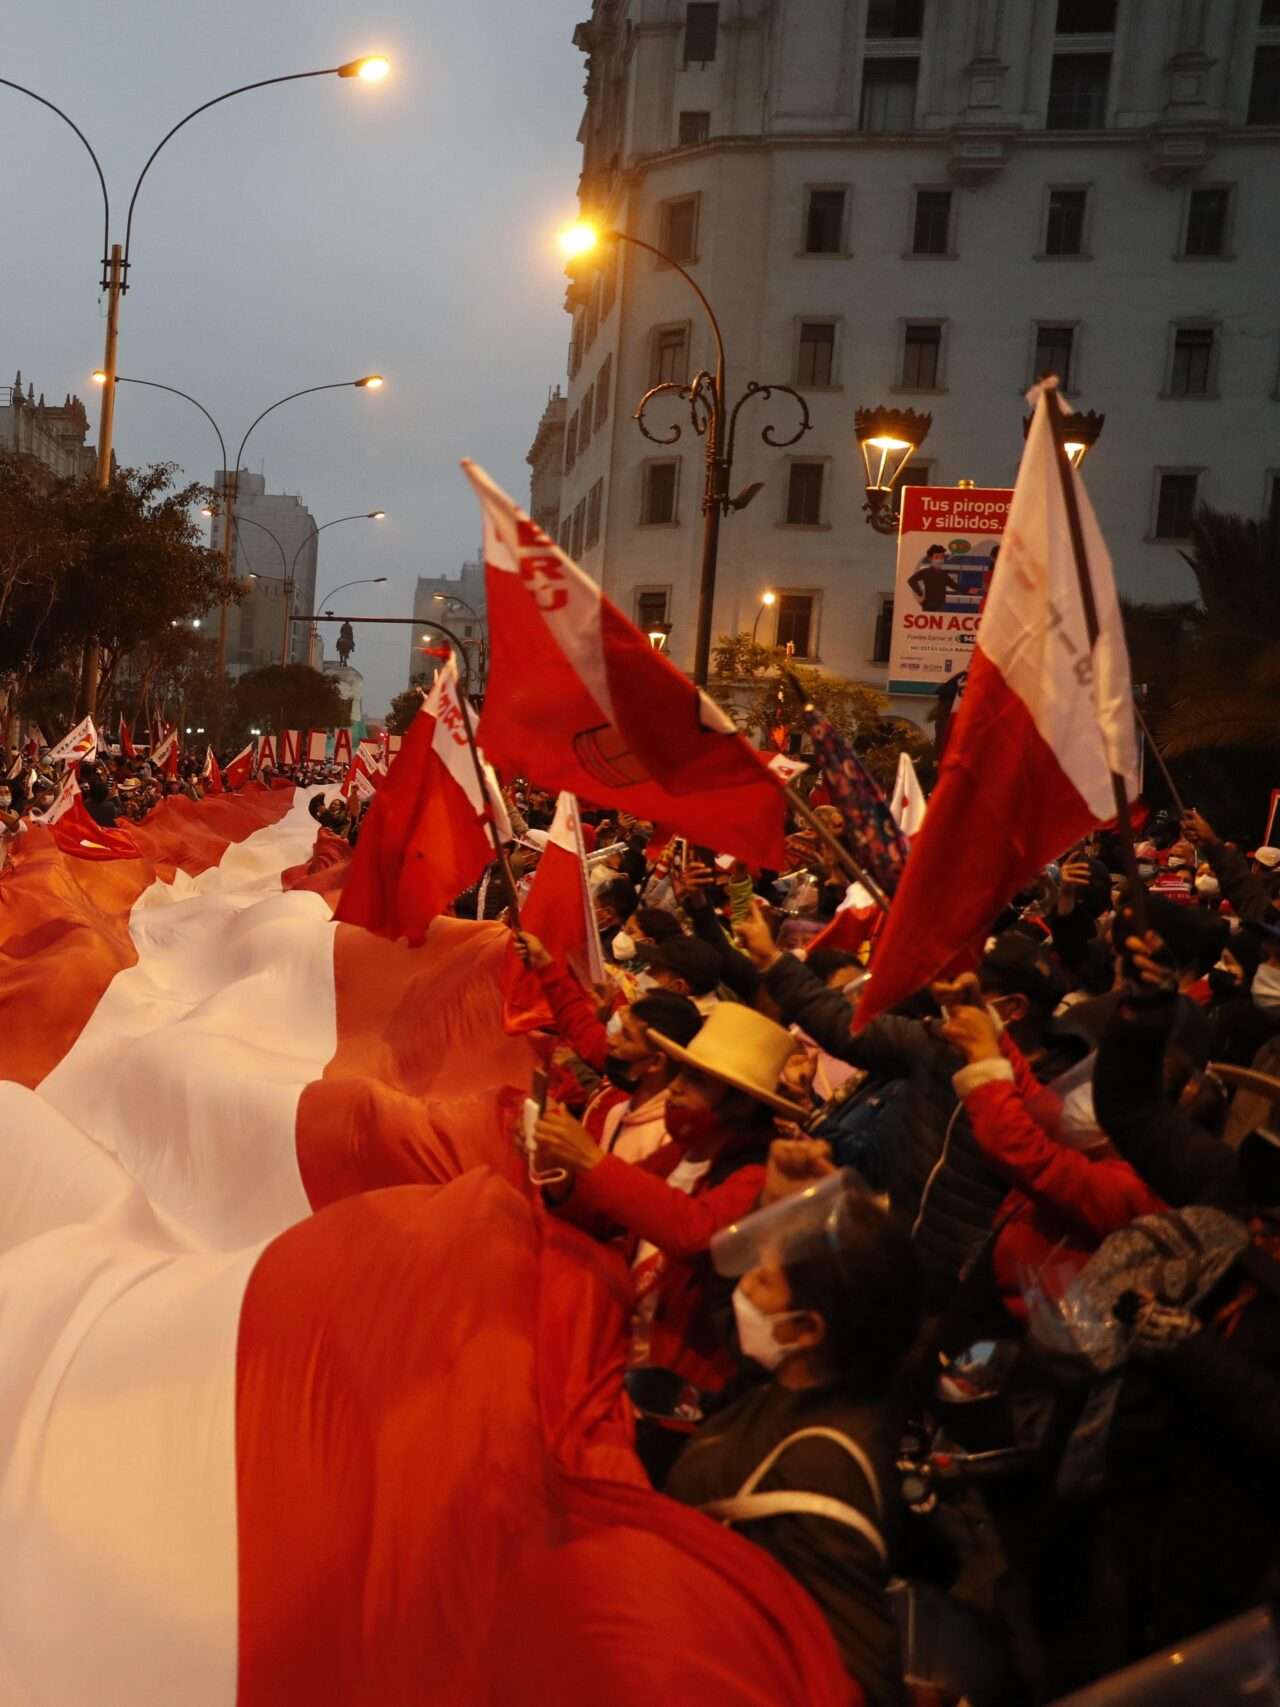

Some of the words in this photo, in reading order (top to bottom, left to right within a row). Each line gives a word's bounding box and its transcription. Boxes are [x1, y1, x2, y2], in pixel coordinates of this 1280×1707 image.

[921, 496, 949, 511] Tus
[953, 498, 1011, 516] piropos
[922, 517, 931, 529] y
[904, 614, 943, 630] SON
